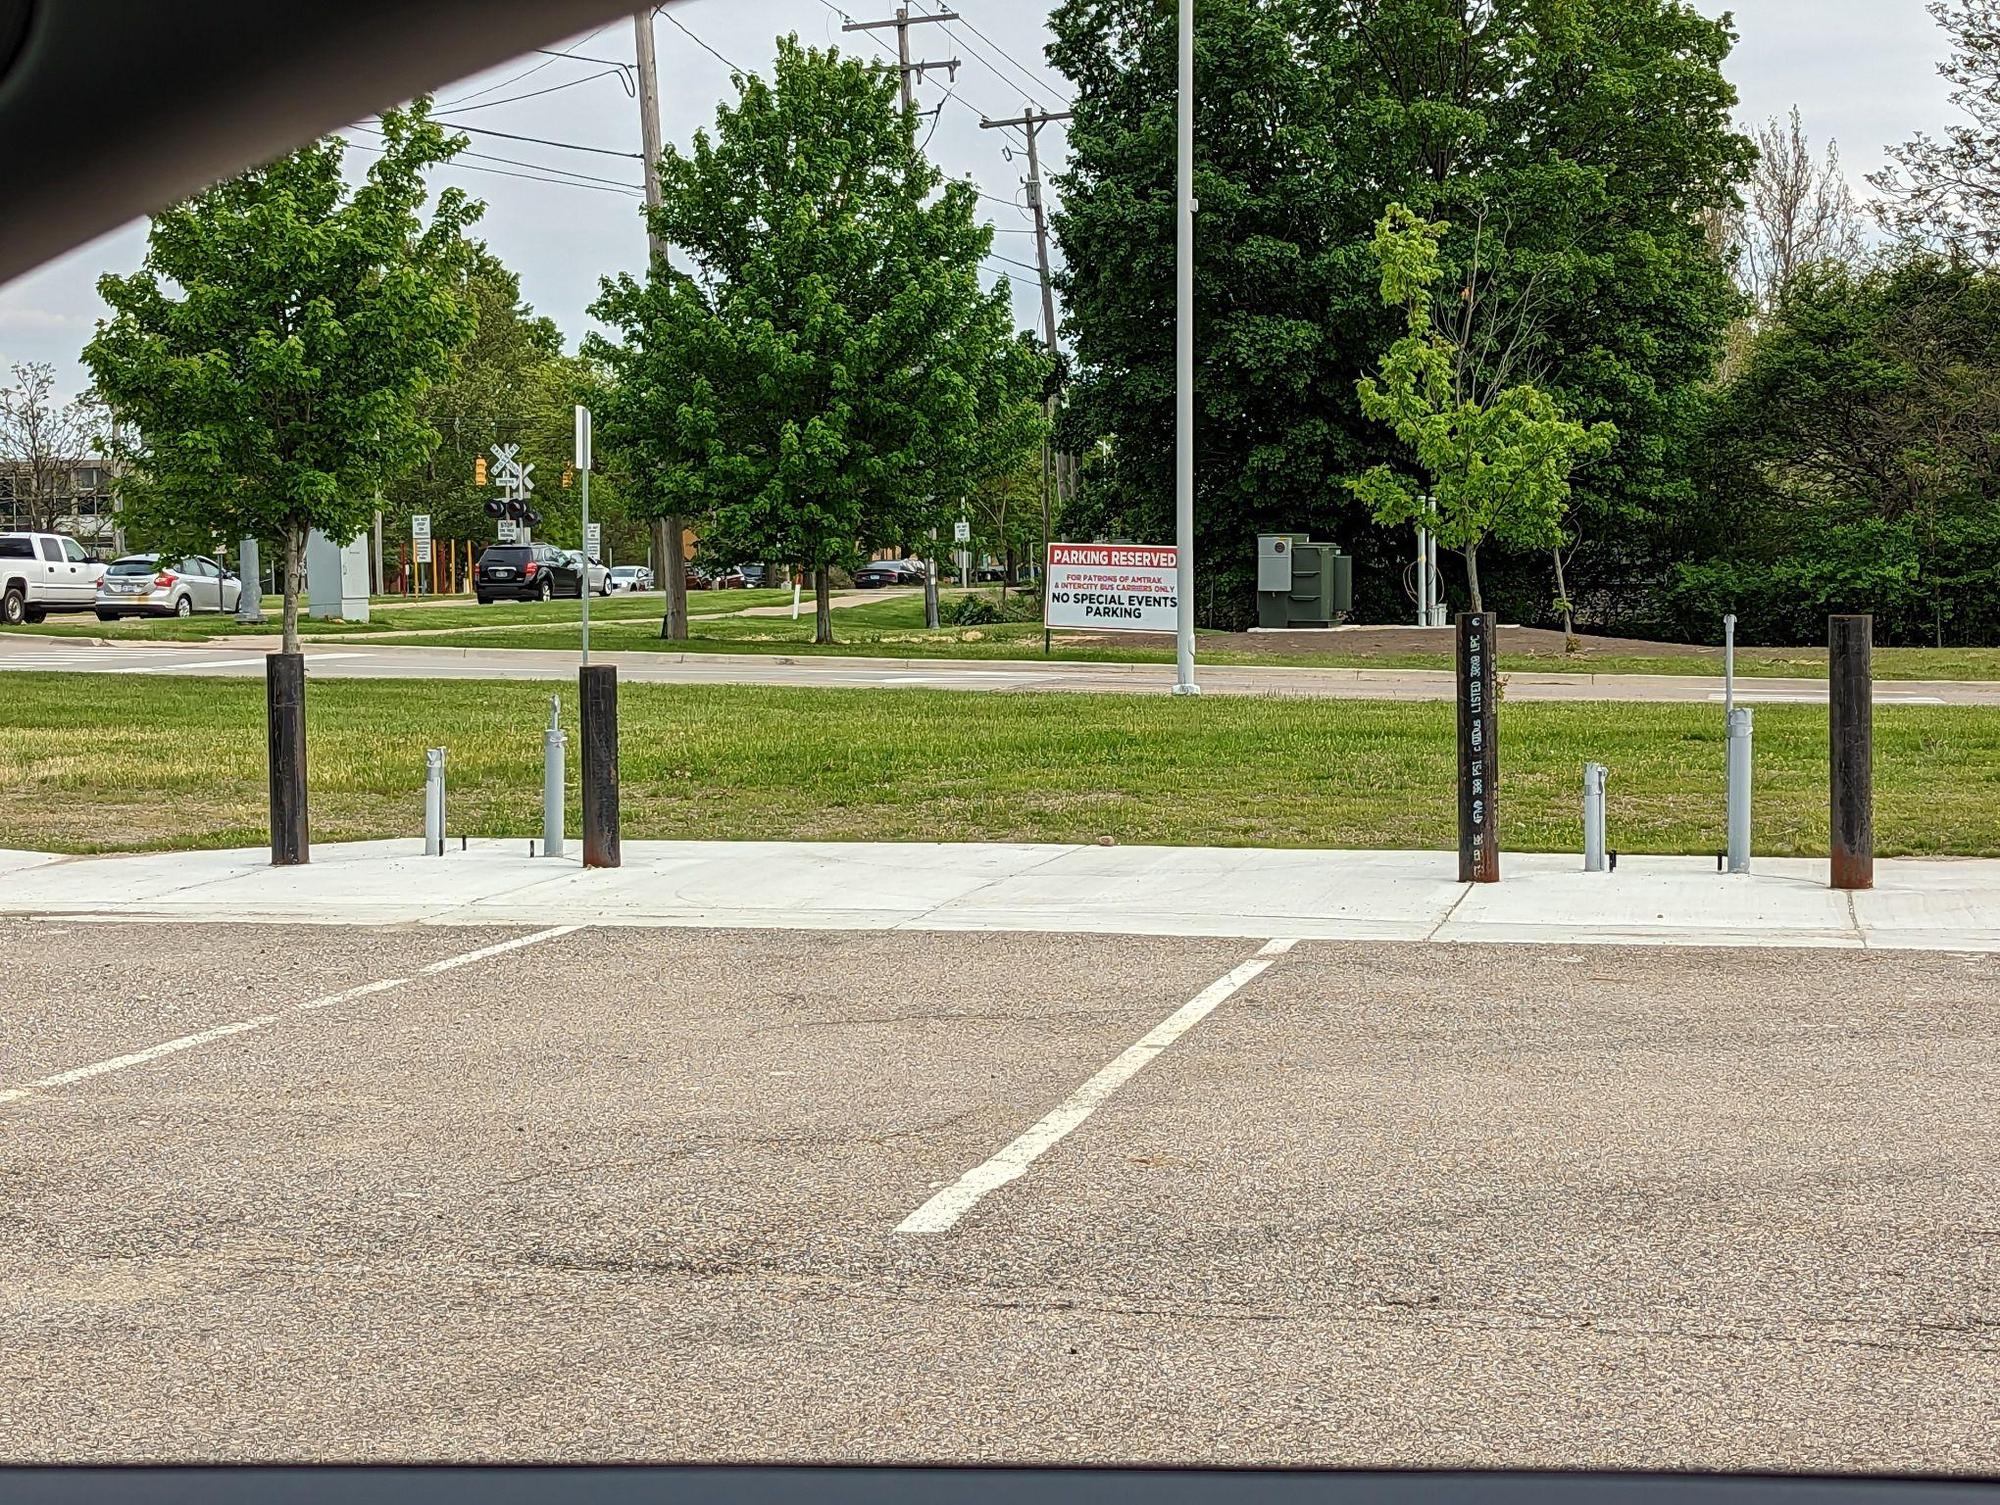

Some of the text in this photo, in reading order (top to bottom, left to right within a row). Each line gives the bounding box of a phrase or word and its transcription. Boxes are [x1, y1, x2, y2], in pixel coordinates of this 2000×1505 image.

[491, 444, 519, 474] CROSSING
[1053, 550, 1176, 567] PARKING RESERVED
[1061, 583, 1098, 591] INTERCITY
[1083, 574, 1118, 583] PATRONS
[1131, 576, 1162, 584] AMTRAK
[1052, 593, 1177, 608] NO SPECIAL EVENTS
[1085, 606, 1142, 618] PARKING
[1470, 634, 1480, 652] UPC
[1470, 681, 1481, 713] LISTED
[1472, 759, 1482, 776] PSI
